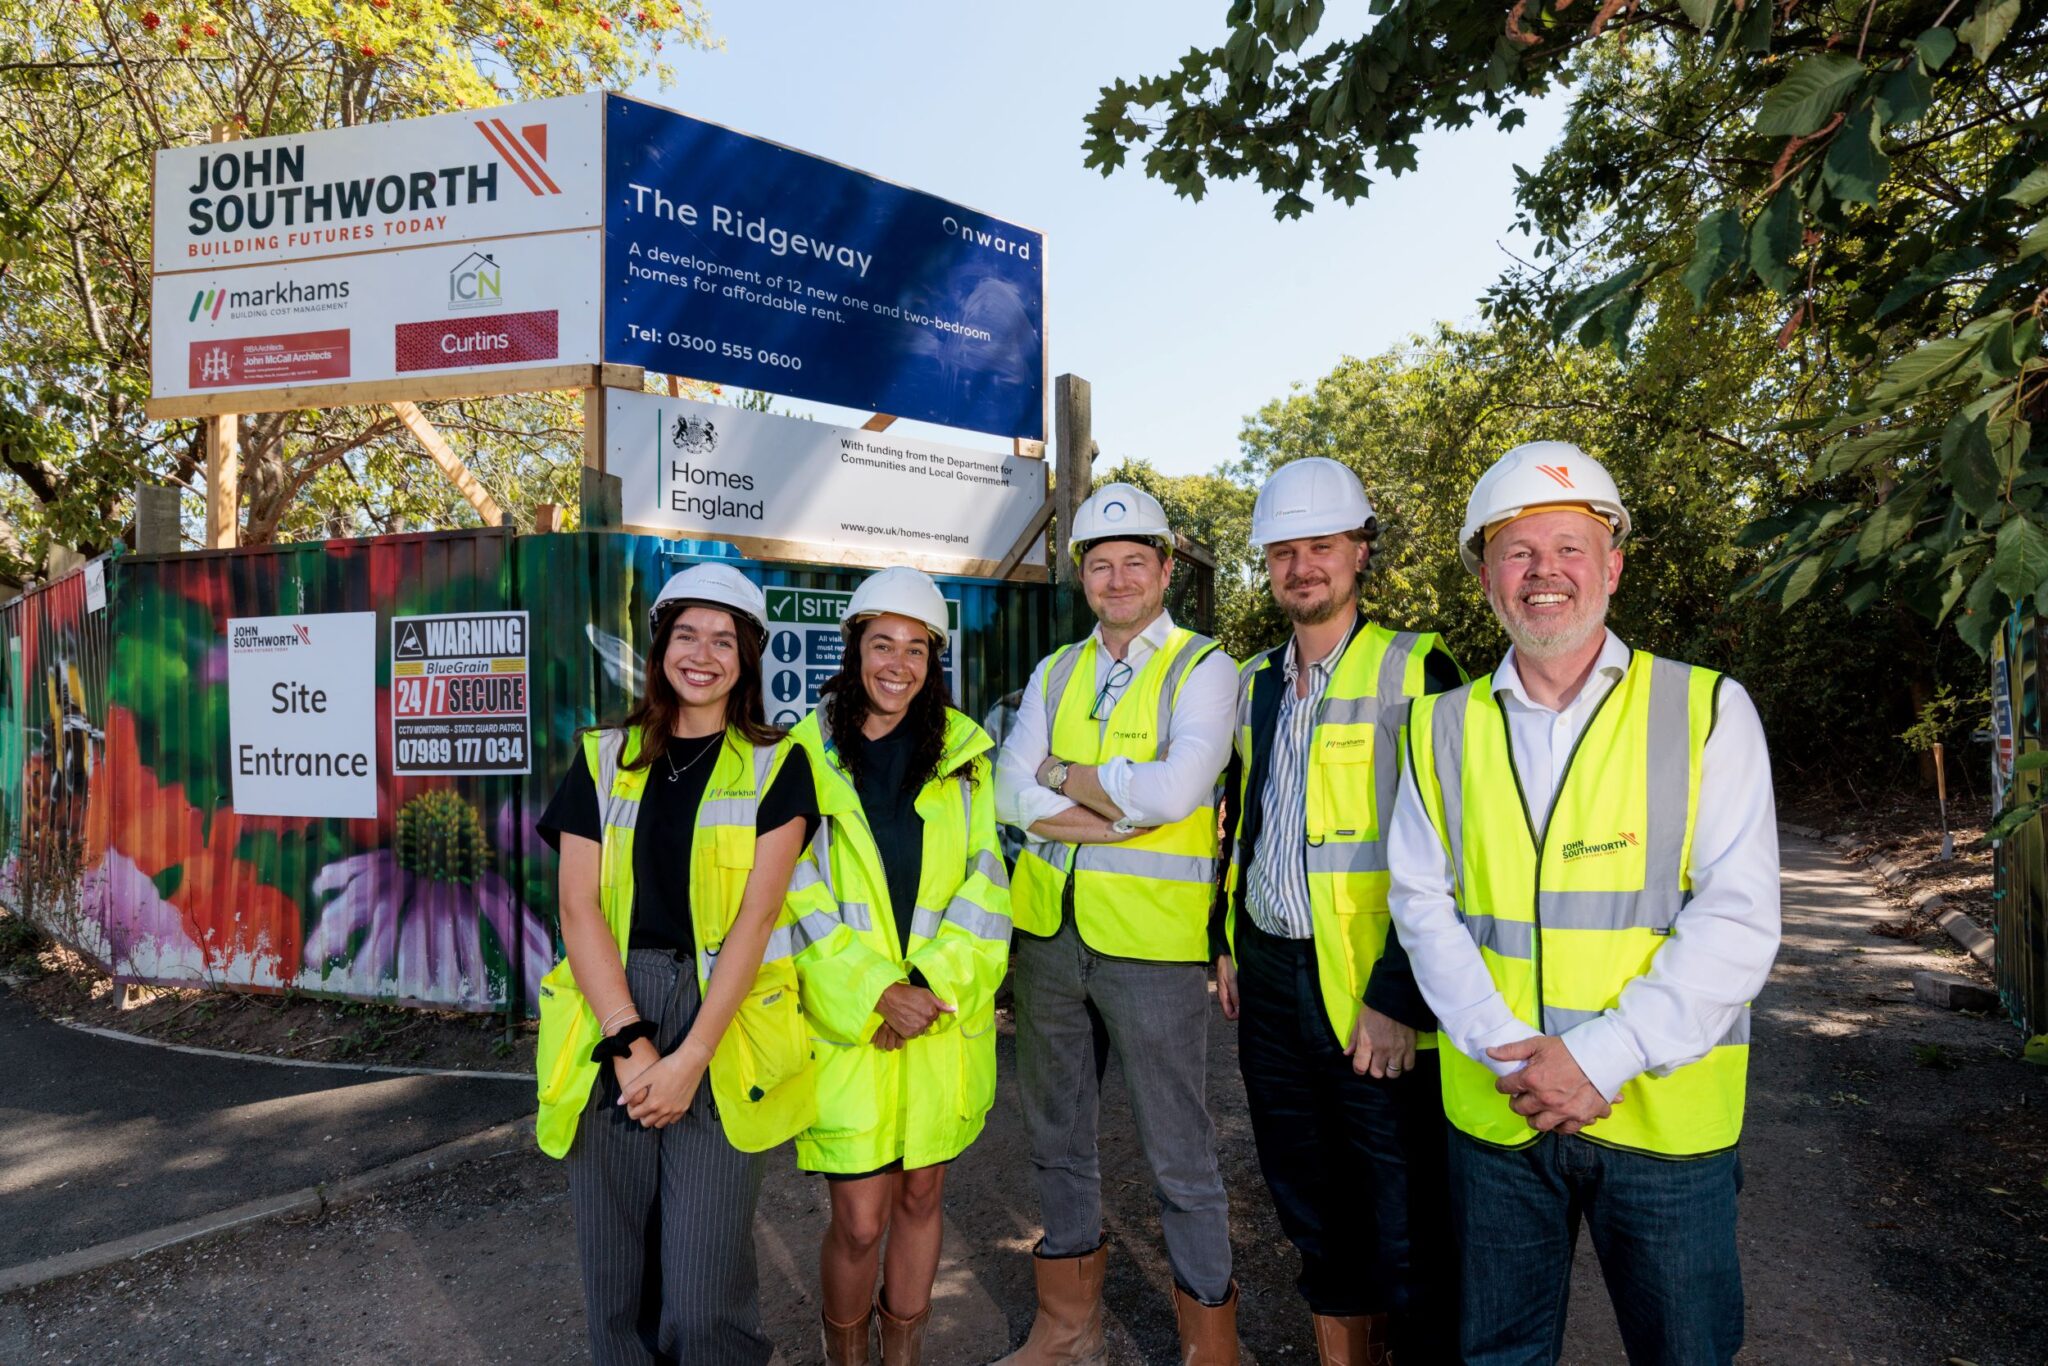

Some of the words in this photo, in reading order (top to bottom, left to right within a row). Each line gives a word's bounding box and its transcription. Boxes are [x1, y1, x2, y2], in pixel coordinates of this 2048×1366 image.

[188, 144, 305, 195] JOHN
[188, 162, 498, 236] SOUTHWORTH
[188, 234, 280, 257] BUILDING
[288, 225, 375, 247] FUTURES
[384, 216, 447, 236] TODAY
[628, 182, 698, 226] The
[712, 204, 873, 278] Ridgeway
[942, 216, 1030, 260] Onward
[230, 280, 350, 308] markhams
[450, 269, 500, 301] ICN
[628, 241, 642, 257] A
[647, 247, 762, 285] development
[765, 275, 784, 290] of
[786, 279, 802, 295] 12
[807, 286, 838, 303] new
[842, 295, 869, 311] one
[873, 302, 900, 319] and
[904, 309, 992, 342] two-bedroom
[628, 261, 689, 289] homes
[693, 277, 718, 293] for
[722, 284, 808, 314] affordable
[811, 306, 846, 324] rent.
[230, 309, 268, 319] BUILDING
[270, 307, 291, 316] COST
[293, 302, 348, 314] MANAGEMENT
[441, 330, 509, 354] Curtins
[628, 324, 662, 343] Tel:
[667, 332, 717, 353] 0300
[722, 342, 753, 360] 555
[757, 350, 802, 370] 0600
[243, 355, 264, 366] John
[265, 353, 292, 364] McCall
[292, 351, 332, 362] Architects
[841, 439, 864, 452] With
[866, 444, 903, 459] funding
[905, 450, 928, 462] from
[930, 454, 945, 465] the
[947, 457, 999, 474] Department
[1000, 465, 1013, 476] for
[841, 453, 906, 472] Communities
[908, 464, 927, 475] and
[929, 467, 954, 480] Local
[956, 472, 1010, 487] Government
[671, 460, 755, 492] Homes
[671, 490, 764, 521] England
[840, 522, 969, 544] www.gov.uk/homes-england
[802, 597, 847, 618] SITE
[234, 626, 258, 637] JOHN
[234, 635, 299, 648] SOUTHWORTH
[425, 618, 521, 657] WARNING
[426, 660, 489, 674] BlueGrain
[271, 681, 327, 714] Site
[398, 676, 446, 716] 24/7
[449, 676, 525, 714] SECURE
[399, 726, 414, 734] CCTV
[414, 725, 449, 734] MONITORING
[454, 724, 475, 733] STATIC
[476, 724, 498, 733] GUARD
[499, 723, 524, 732] PATROL
[238, 744, 369, 777] Entrance
[398, 738, 451, 763] 07989
[454, 738, 481, 763] 177
[485, 737, 523, 763] 034
[1562, 839, 1584, 852] JOHN
[1562, 840, 1627, 859] SOUTHWORTH
